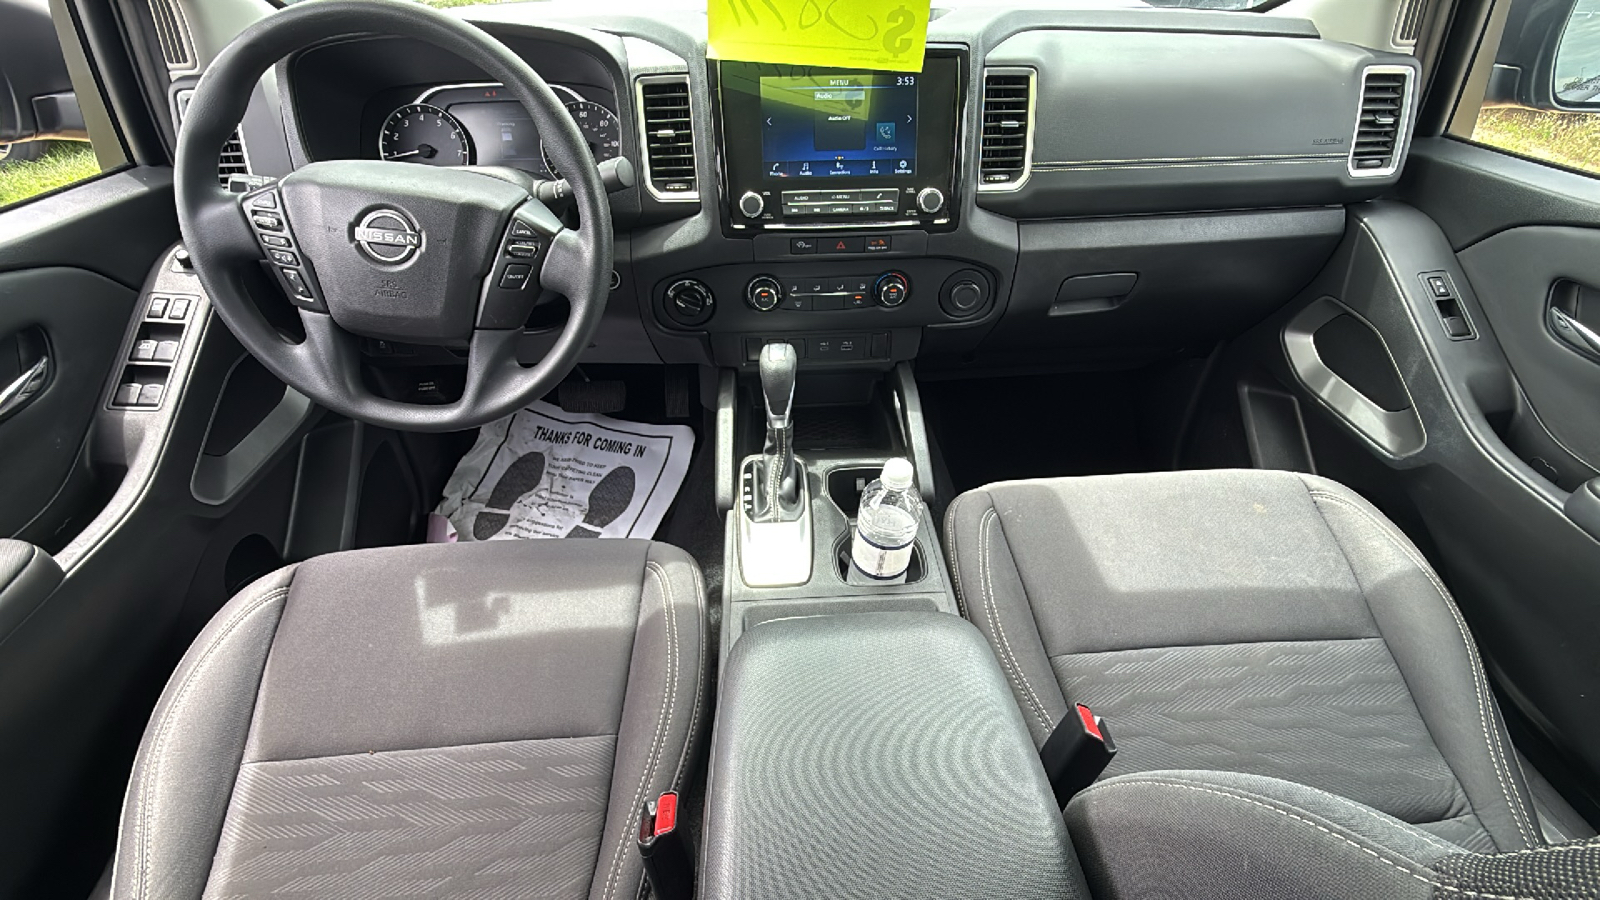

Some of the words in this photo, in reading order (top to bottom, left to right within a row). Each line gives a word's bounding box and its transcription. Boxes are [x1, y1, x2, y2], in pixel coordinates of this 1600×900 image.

[896, 76, 915, 86] 3:53
[403, 119, 409, 127] 3
[436, 119, 442, 127] 5
[393, 132, 399, 140] 2
[450, 131, 456, 139] 6
[457, 149, 462, 157] 7
[357, 230, 418, 245] NISSAN
[374, 289, 409, 299] AIRBAG
[534, 425, 572, 444] THANKS
[571, 431, 593, 448] FOR
[593, 437, 633, 455] COMING
[633, 444, 647, 458] IN
